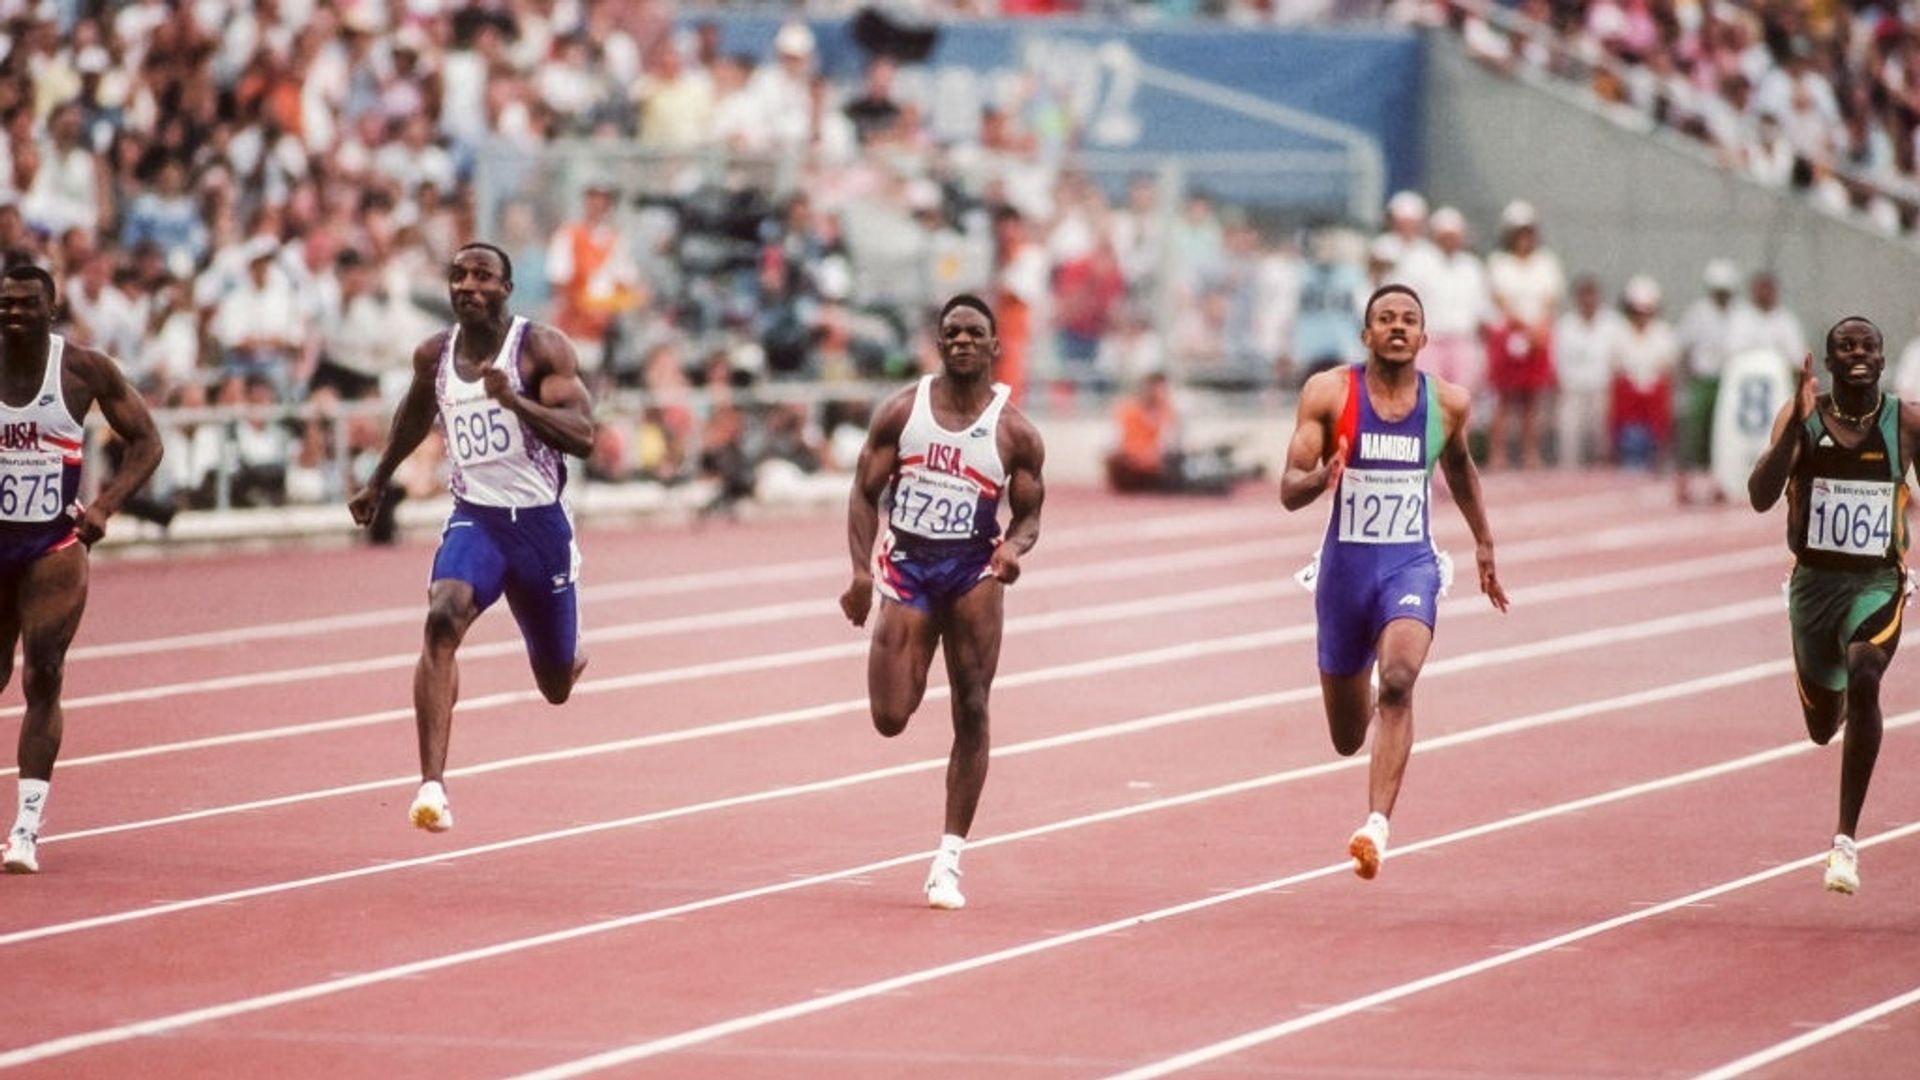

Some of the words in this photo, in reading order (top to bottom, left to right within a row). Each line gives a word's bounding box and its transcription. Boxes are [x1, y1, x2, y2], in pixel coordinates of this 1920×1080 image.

[1738, 374, 1772, 437] 8
[4, 421, 39, 450] USA
[454, 408, 510, 460] 695
[1360, 432, 1421, 463] NAMIBIA
[927, 442, 961, 477] USA
[0, 472, 61, 516] 675
[899, 486, 972, 534] 1738
[1345, 491, 1422, 537] 1272
[1814, 501, 1890, 549] 1064
